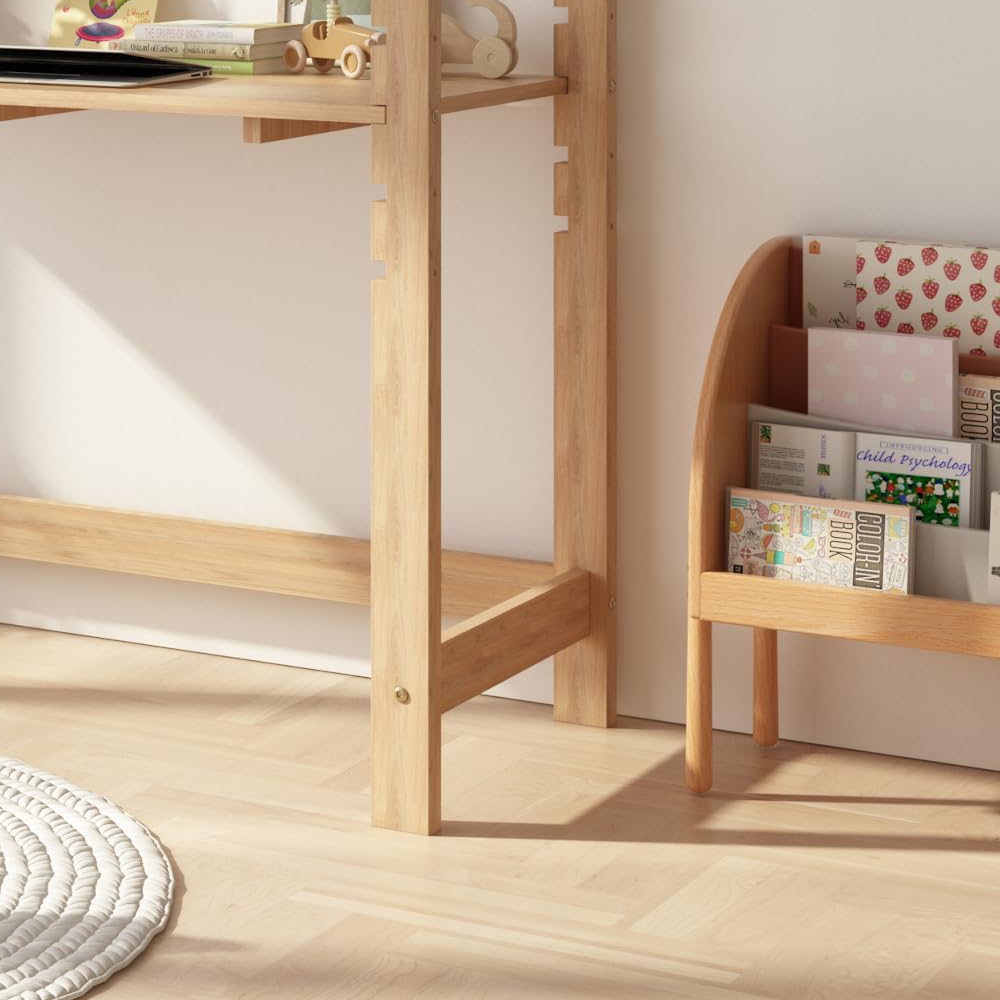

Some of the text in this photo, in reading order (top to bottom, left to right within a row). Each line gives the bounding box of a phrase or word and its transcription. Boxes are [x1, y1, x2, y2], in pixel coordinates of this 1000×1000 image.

[856, 449, 972, 478] Child Psychology
[829, 519, 854, 561] BOOK
